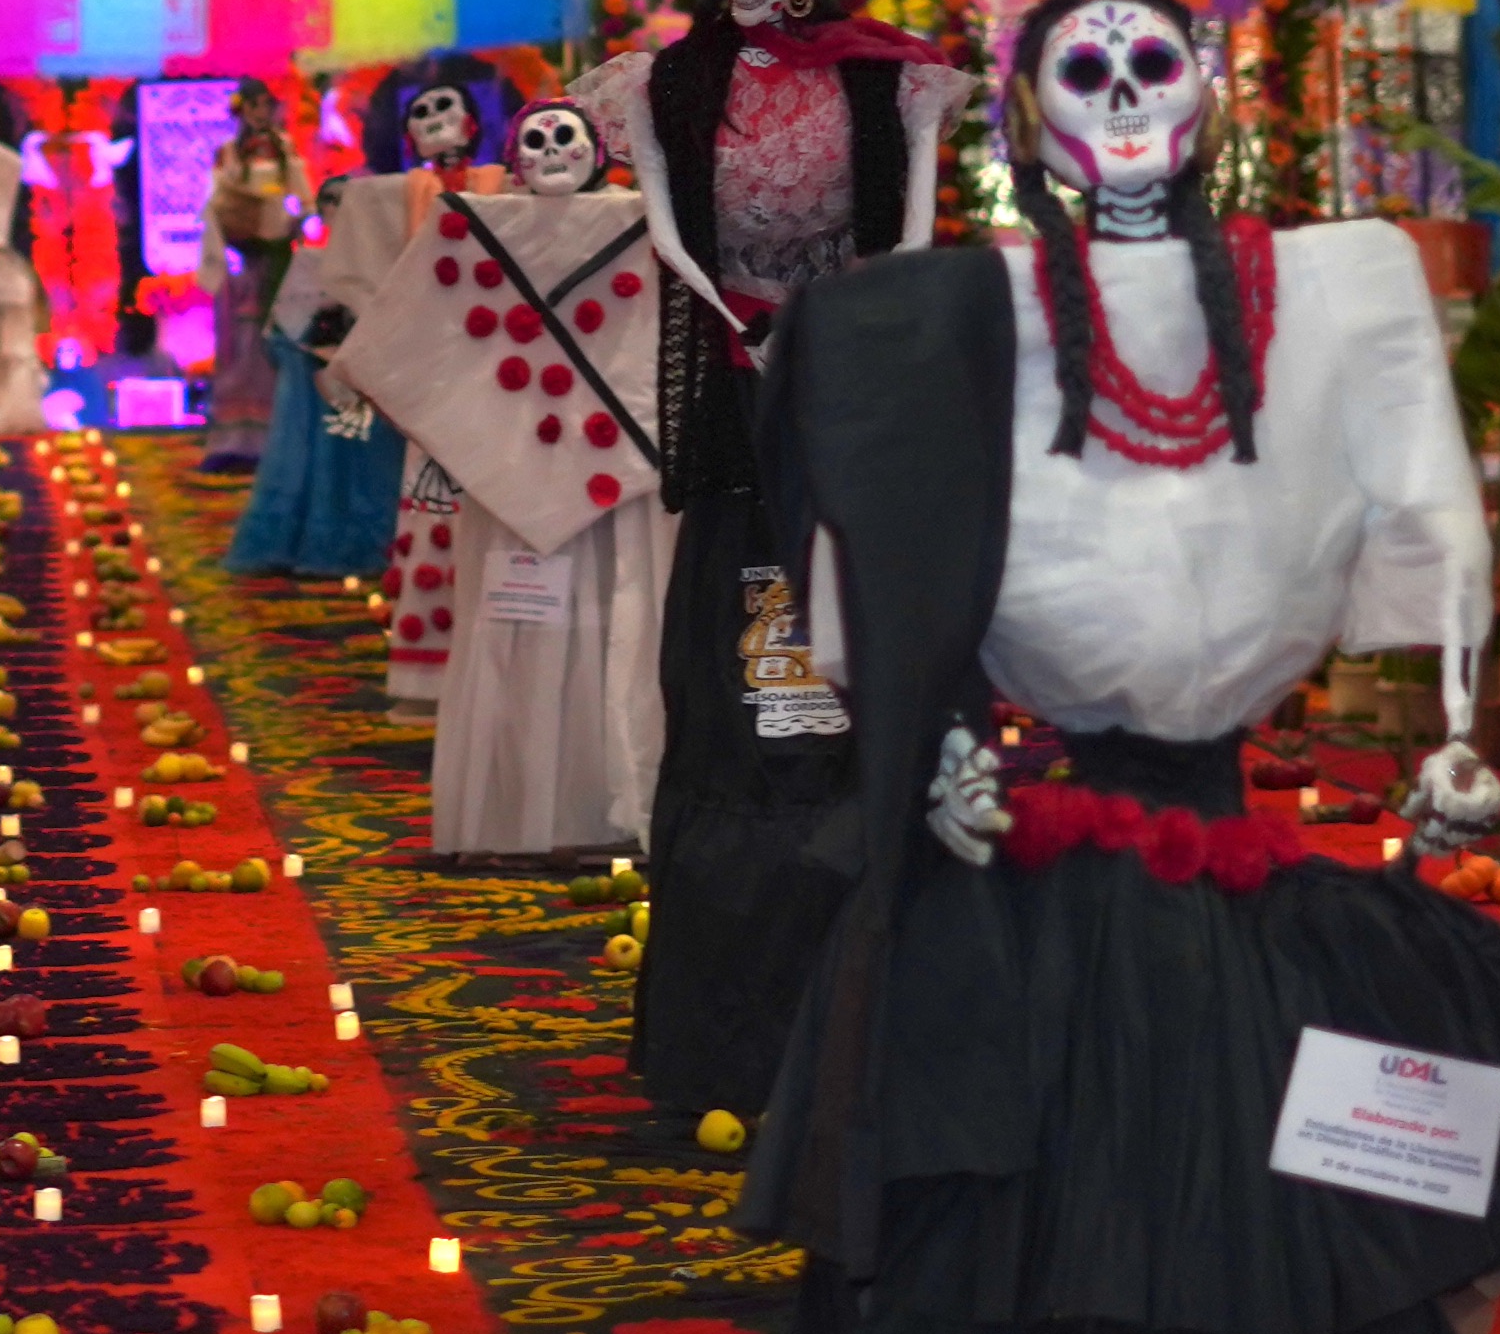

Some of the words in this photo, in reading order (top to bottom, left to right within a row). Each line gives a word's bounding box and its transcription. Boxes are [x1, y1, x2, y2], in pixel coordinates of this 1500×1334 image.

[742, 691, 837, 703] MESOAMERIC
[758, 703, 778, 713] DE
[1352, 1107, 1427, 1134] Elaborado
